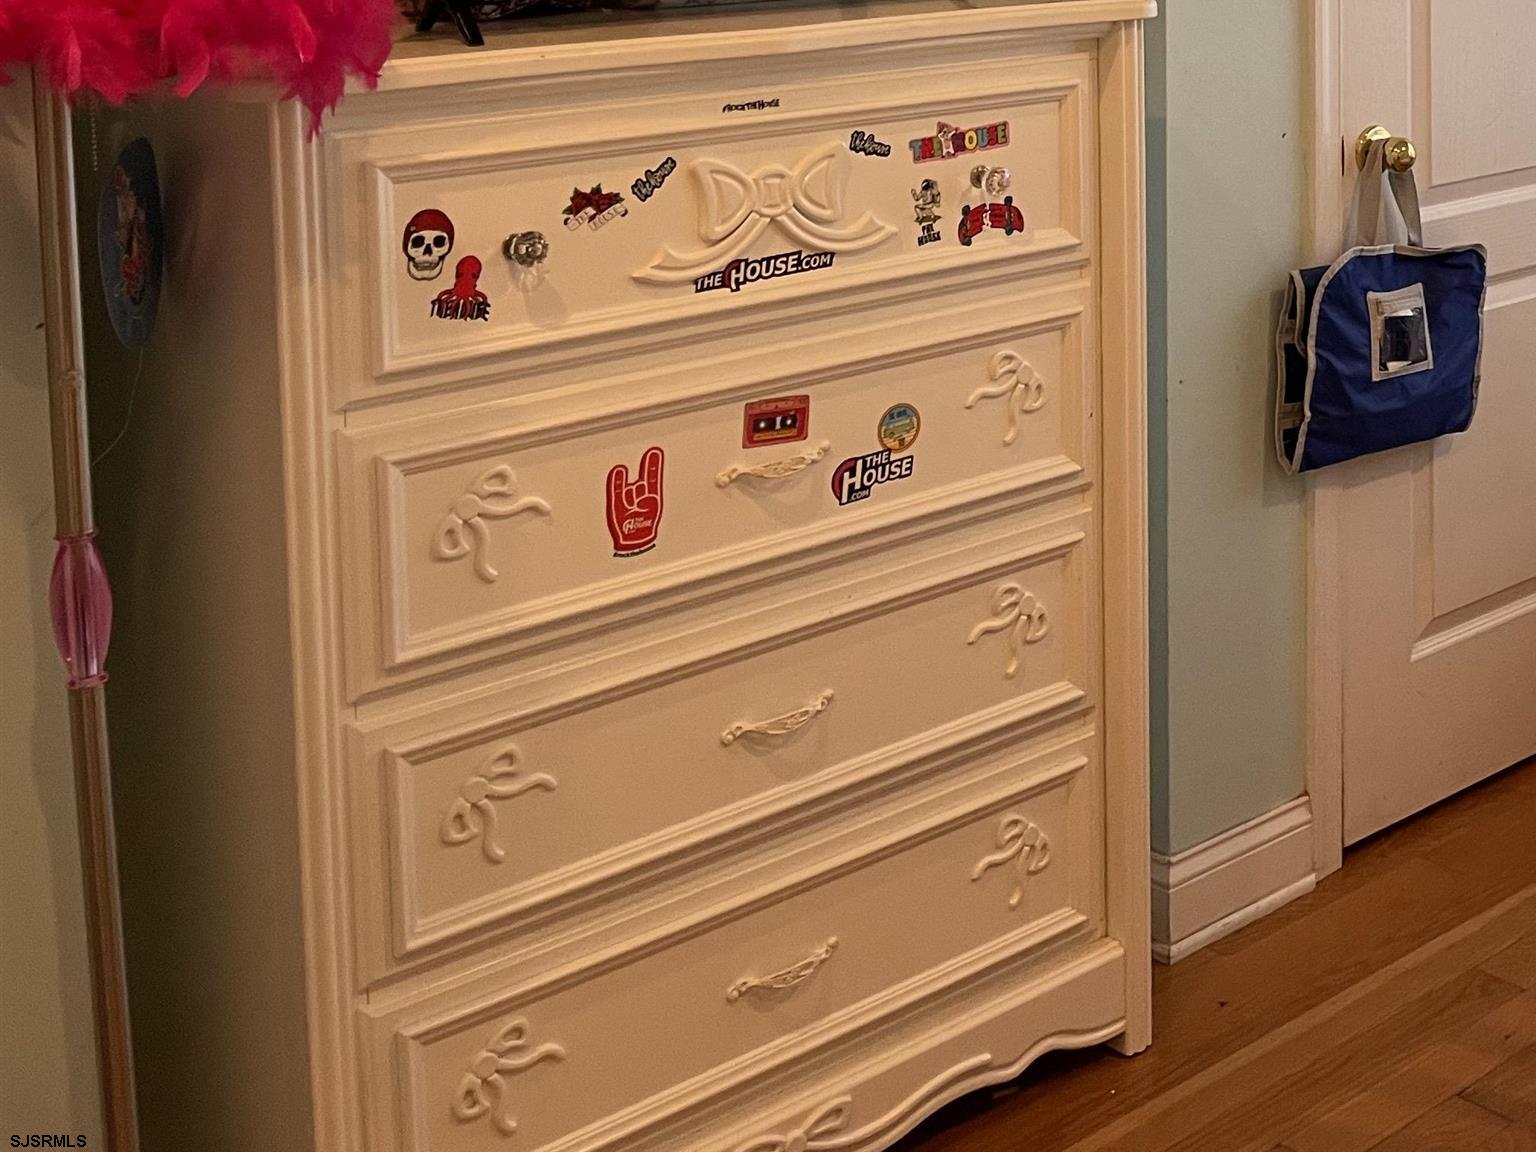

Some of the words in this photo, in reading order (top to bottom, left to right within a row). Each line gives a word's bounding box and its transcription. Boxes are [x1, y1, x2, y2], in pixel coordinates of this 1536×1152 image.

[696, 273, 724, 290] THE
[865, 450, 890, 467] THE
[841, 457, 912, 504] HOUSE
